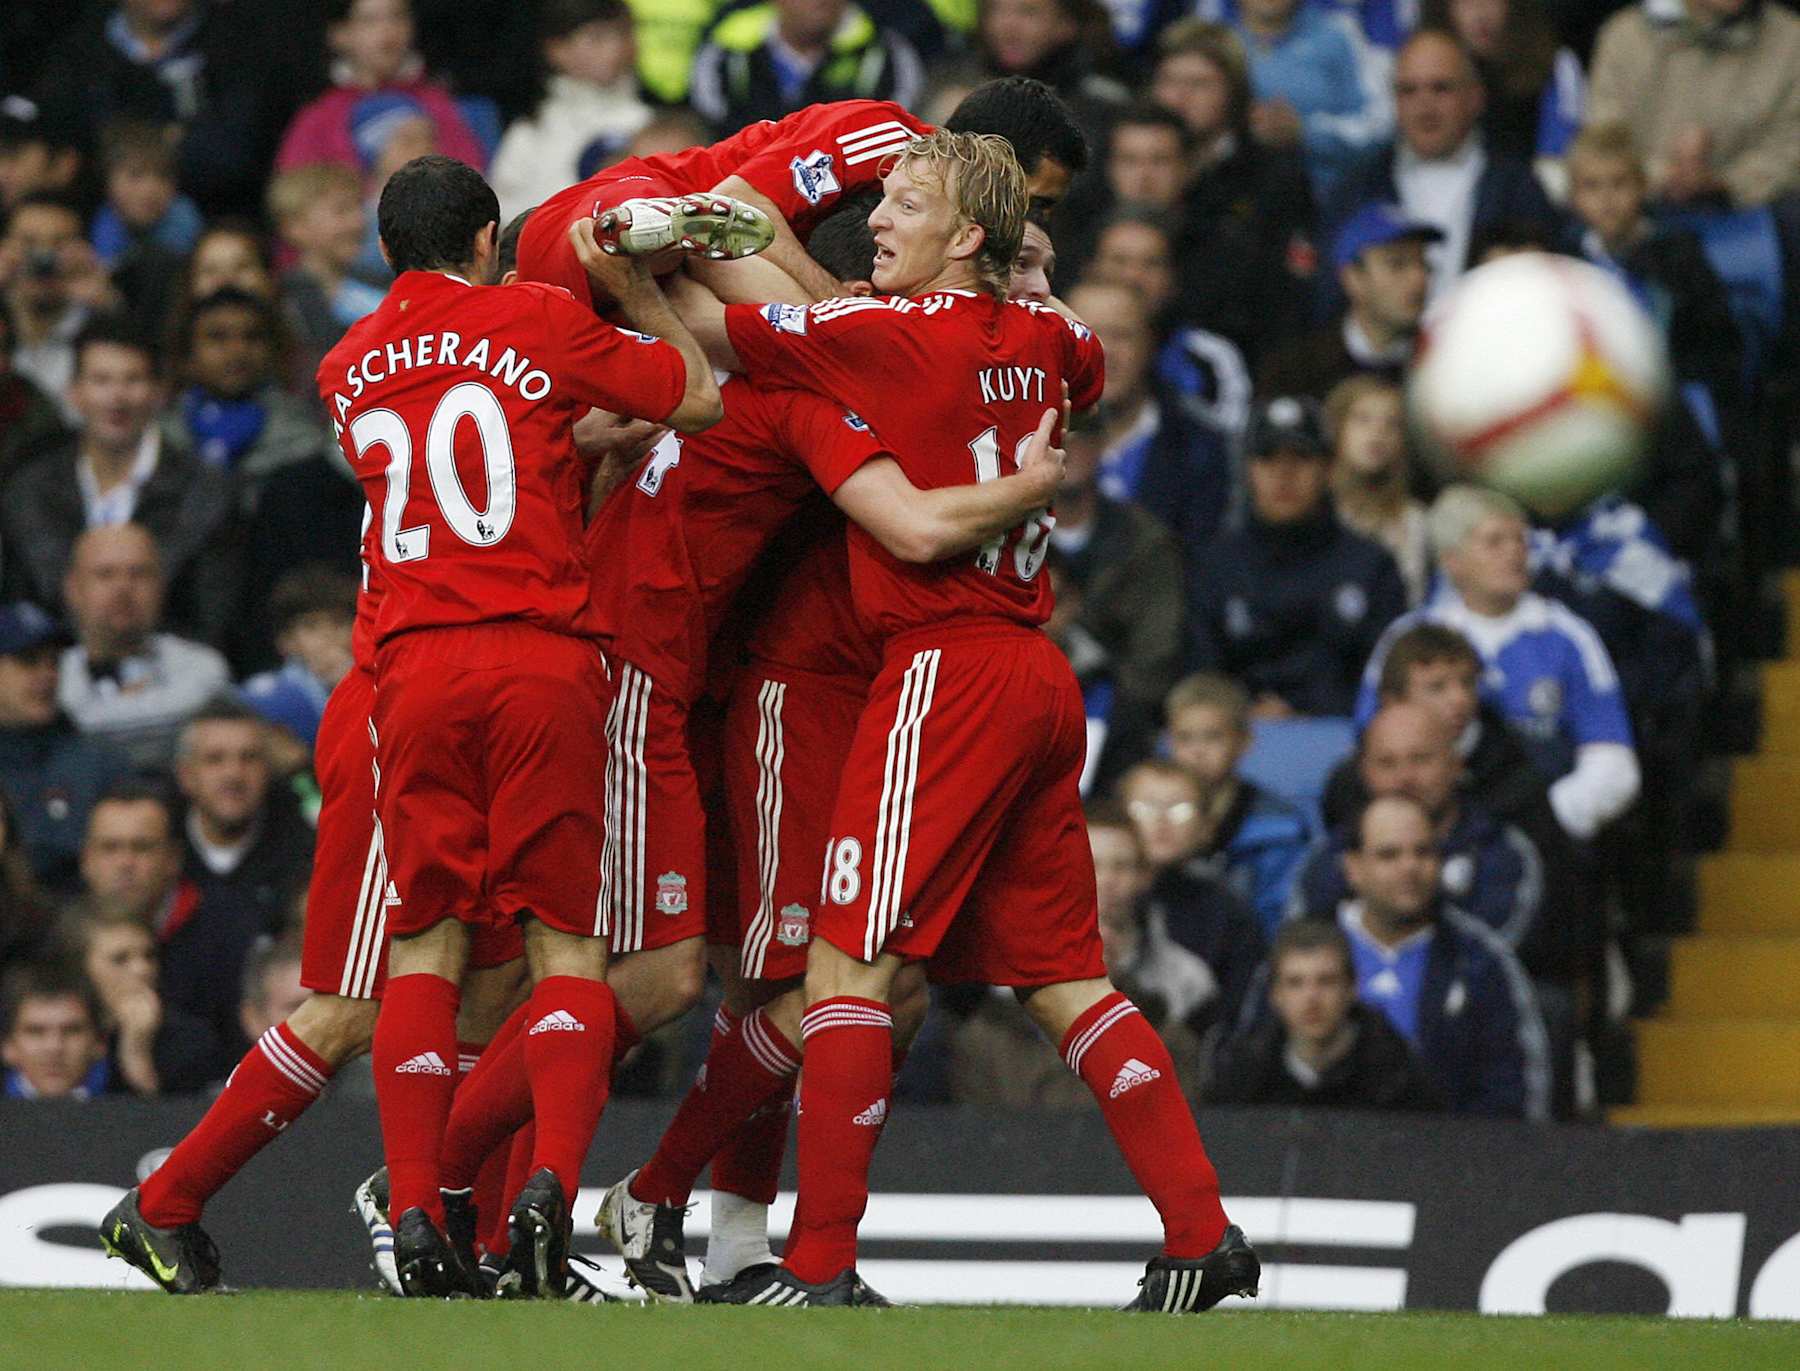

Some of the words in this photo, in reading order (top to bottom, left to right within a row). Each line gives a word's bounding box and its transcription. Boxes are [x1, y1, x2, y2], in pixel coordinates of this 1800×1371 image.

[978, 366, 1046, 404] KUYT
[349, 381, 517, 564] 20
[529, 1020, 586, 1035] adidas
[395, 1062, 452, 1076] adidas
[1109, 1069, 1161, 1099] adidas
